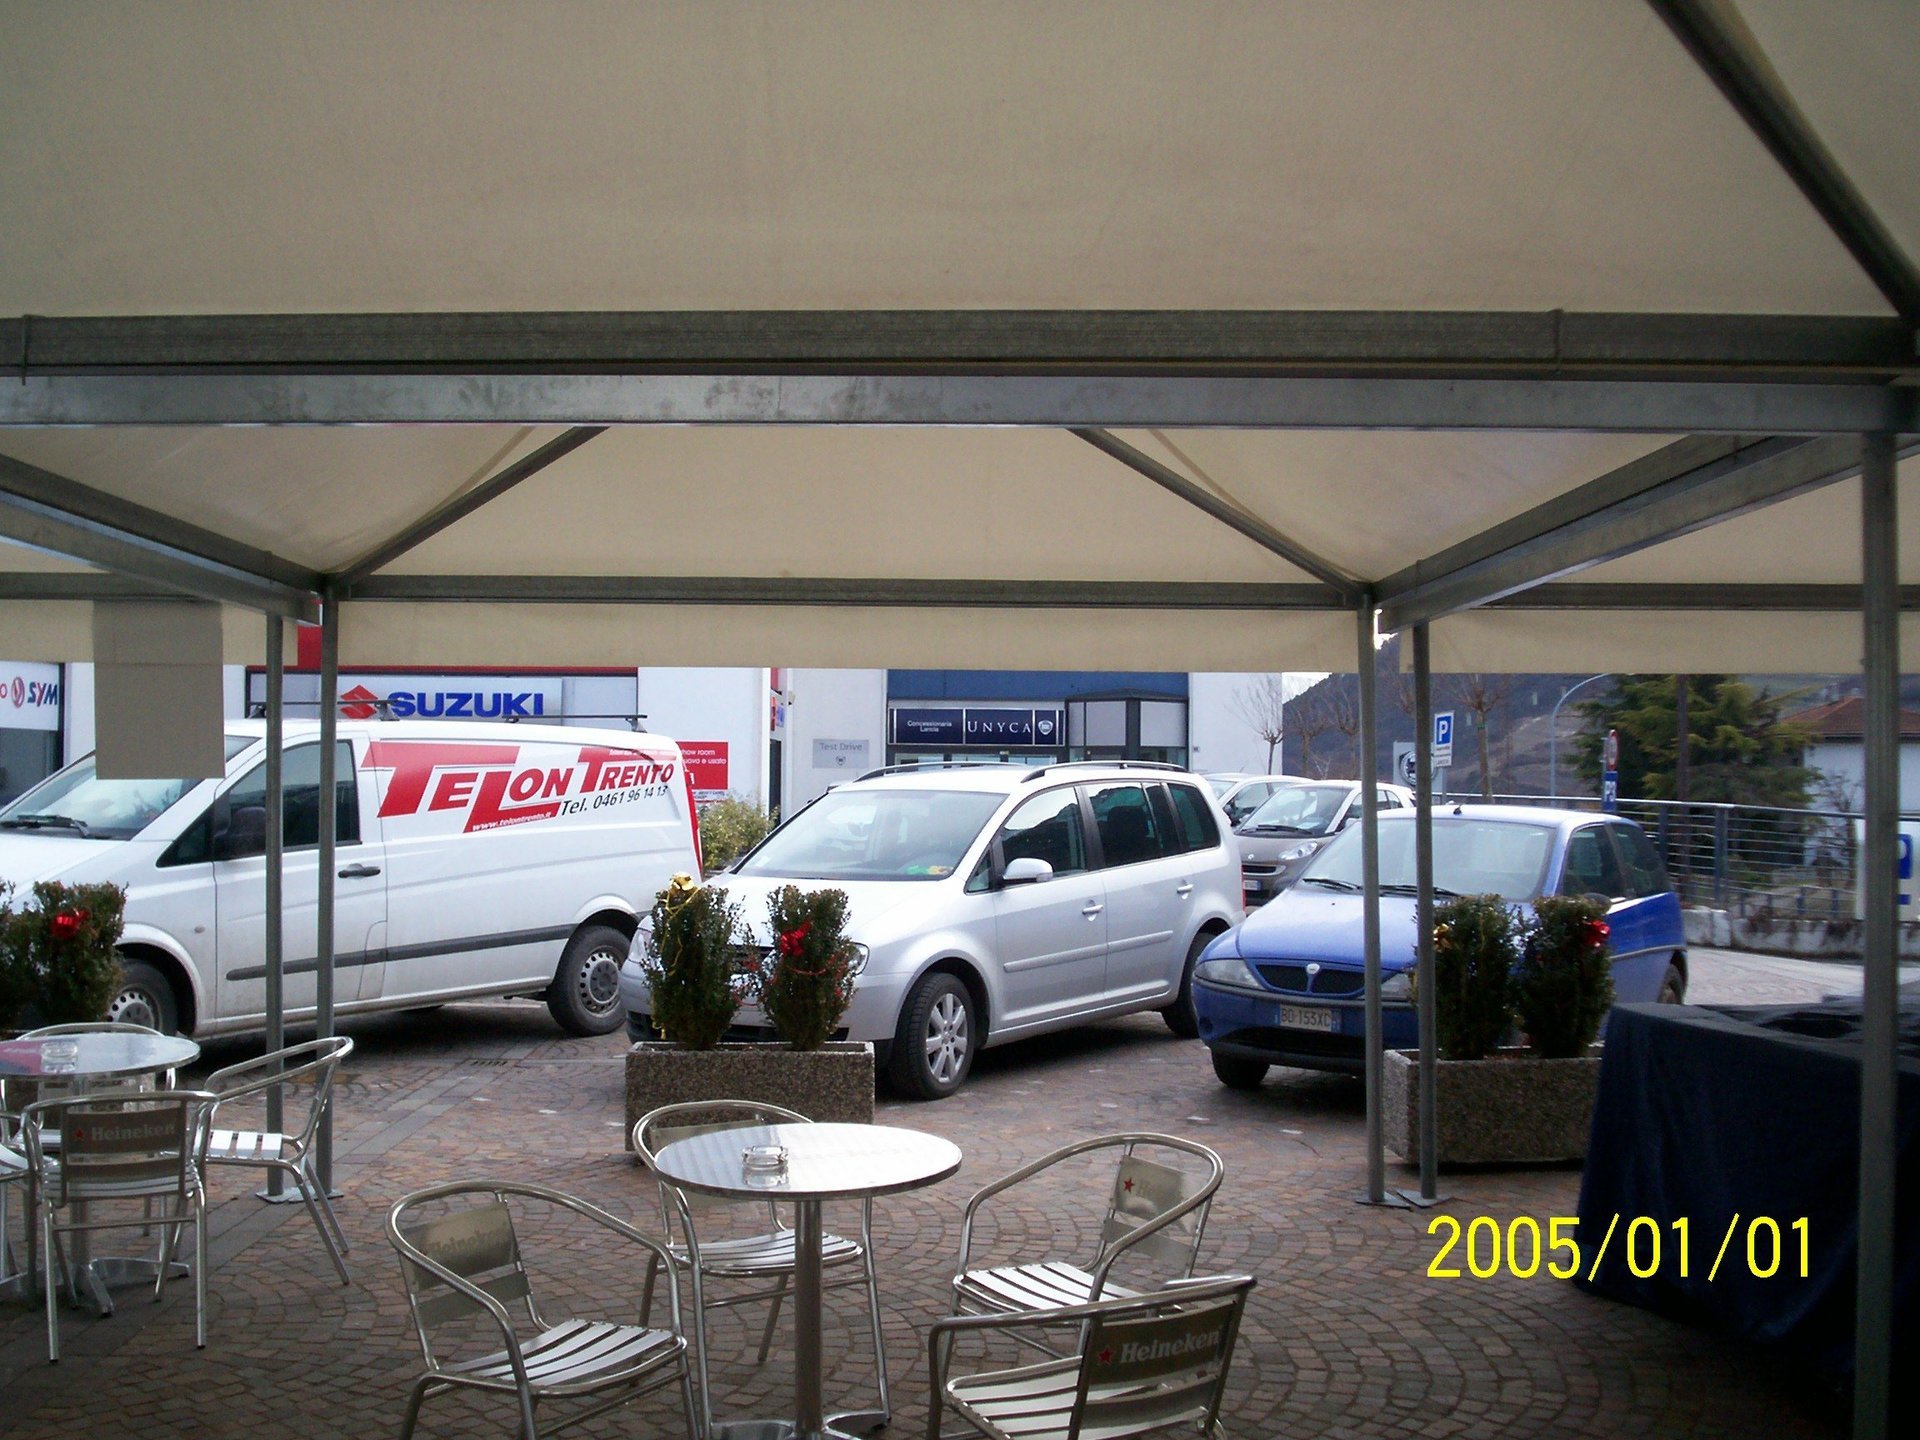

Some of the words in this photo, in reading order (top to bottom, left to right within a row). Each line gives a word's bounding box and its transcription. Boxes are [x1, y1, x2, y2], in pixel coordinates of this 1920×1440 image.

[27, 681, 58, 707] SYM
[387, 691, 544, 717] SUZUKI
[967, 721, 1032, 733] UNYCA
[1438, 720, 1449, 742] P
[820, 742, 837, 751] Test
[839, 742, 862, 751] Drive
[361, 741, 574, 833] TELON
[577, 746, 677, 793] TRENTO
[561, 799, 588, 816] Tel.
[593, 791, 625, 809] 0461
[627, 789, 641, 802] 96
[643, 787, 655, 799] 14
[656, 785, 669, 796] 13
[92, 1122, 176, 1141] Heineken
[1119, 1330, 1220, 1364] Heineken
